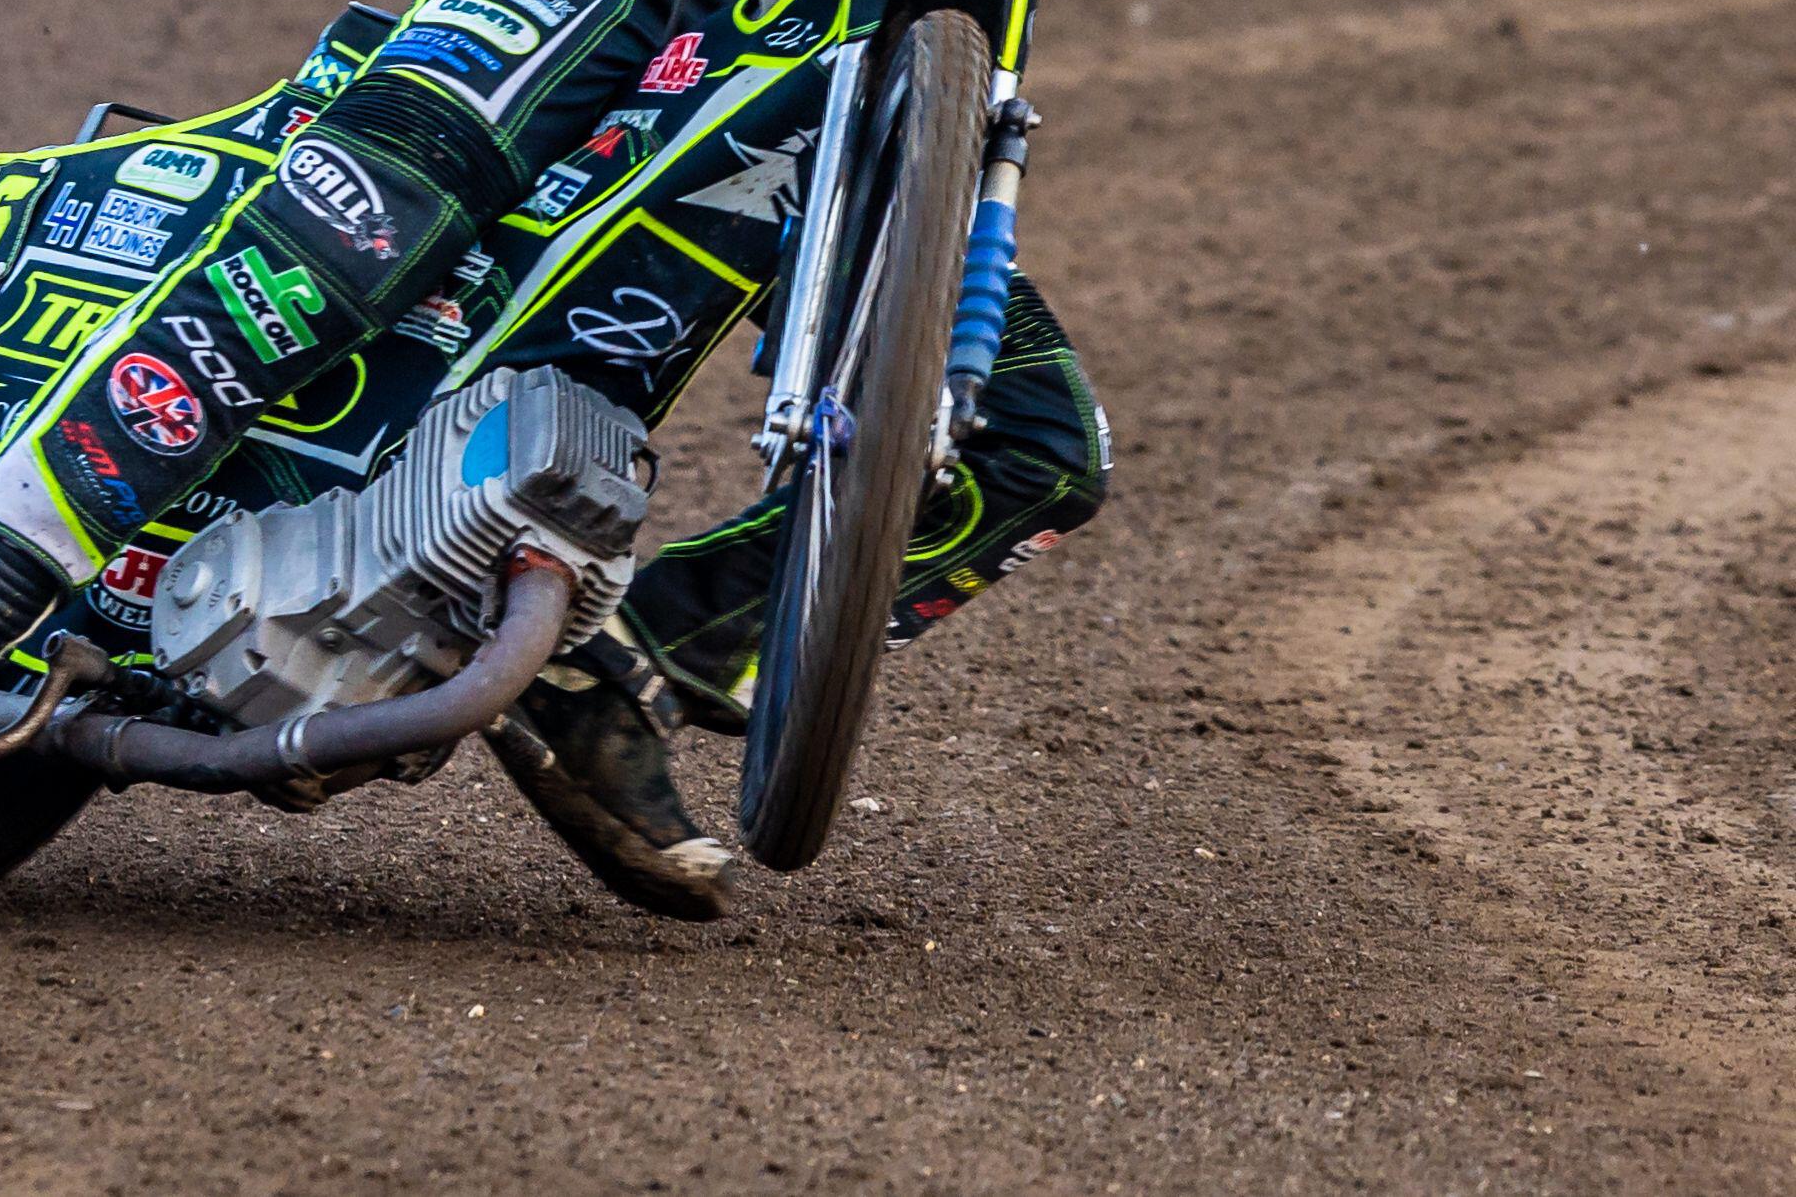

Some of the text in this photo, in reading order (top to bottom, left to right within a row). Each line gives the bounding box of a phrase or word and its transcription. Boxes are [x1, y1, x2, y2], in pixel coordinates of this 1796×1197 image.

[89, 224, 165, 260] HOLDINGS
[21, 292, 118, 351] TR
[224, 256, 299, 356] ROCK OIL
